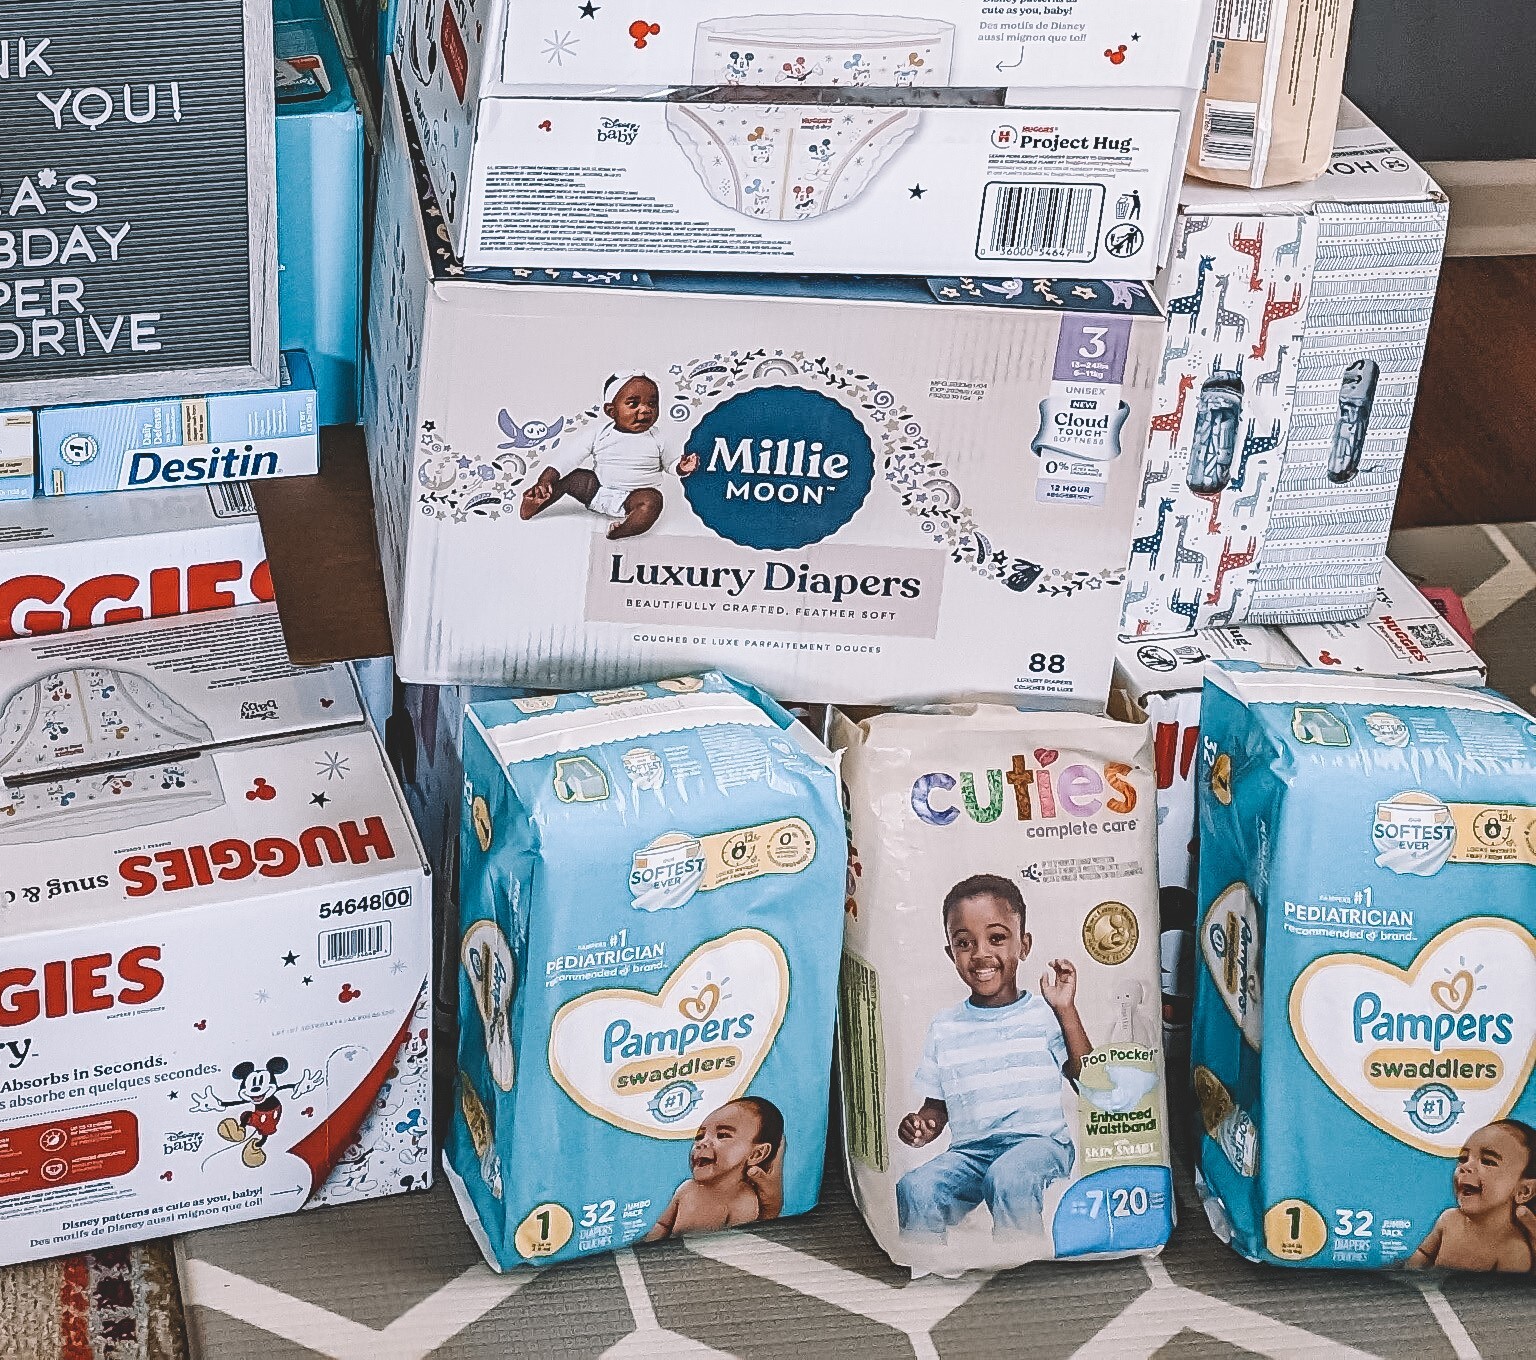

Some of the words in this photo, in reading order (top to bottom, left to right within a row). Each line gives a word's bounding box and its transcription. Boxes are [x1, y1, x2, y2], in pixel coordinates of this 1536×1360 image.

[36, 80, 184, 131] YOU!
[597, 126, 639, 147] baby
[1019, 133, 1089, 153] Project
[1092, 134, 1133, 155] Hug
[1065, 386, 1106, 397] UNISEX
[1072, 400, 1096, 410] NEW
[1053, 412, 1110, 431] Cloud
[1057, 427, 1101, 438] TOUCH
[127, 445, 279, 487] Desitin
[706, 435, 850, 481] Millie
[609, 554, 754, 598] Luxury
[763, 561, 922, 602] Diapers
[625, 597, 718, 612] BEAUTIFULLY
[794, 607, 856, 621] FEATHER
[861, 610, 897, 621] SOFT
[1028, 652, 1066, 674] 88
[910, 747, 1140, 827] cuties
[1025, 821, 1100, 841] complete
[1102, 819, 1137, 835] care
[1374, 823, 1455, 843] SOFTEST
[122, 815, 398, 900] HUGGIES
[1398, 839, 1430, 852] EVER
[630, 857, 706, 885] SOFTEST
[652, 876, 682, 891] EVER
[318, 887, 413, 921] 5464800
[1283, 901, 1414, 927] PEDIATRICIAN
[1283, 925, 1365, 941] recommended
[1380, 930, 1414, 942] brand
[546, 942, 665, 976] PEDIATRICIAN
[1352, 991, 1514, 1051] Pampers
[602, 1012, 755, 1064] Pampers
[0, 1071, 71, 1095] Absorbs
[72, 1067, 90, 1082] in
[92, 1053, 169, 1078] Seconds.
[615, 1053, 737, 1090] swaddlers
[1368, 1058, 1498, 1080] swaddlers
[1089, 1109, 1153, 1124] Enhanced
[163, 1135, 204, 1156] baby
[579, 1199, 616, 1229] 32
[1084, 1190, 1103, 1220] 7
[1113, 1185, 1148, 1218] 20
[1333, 1209, 1373, 1237] 32
